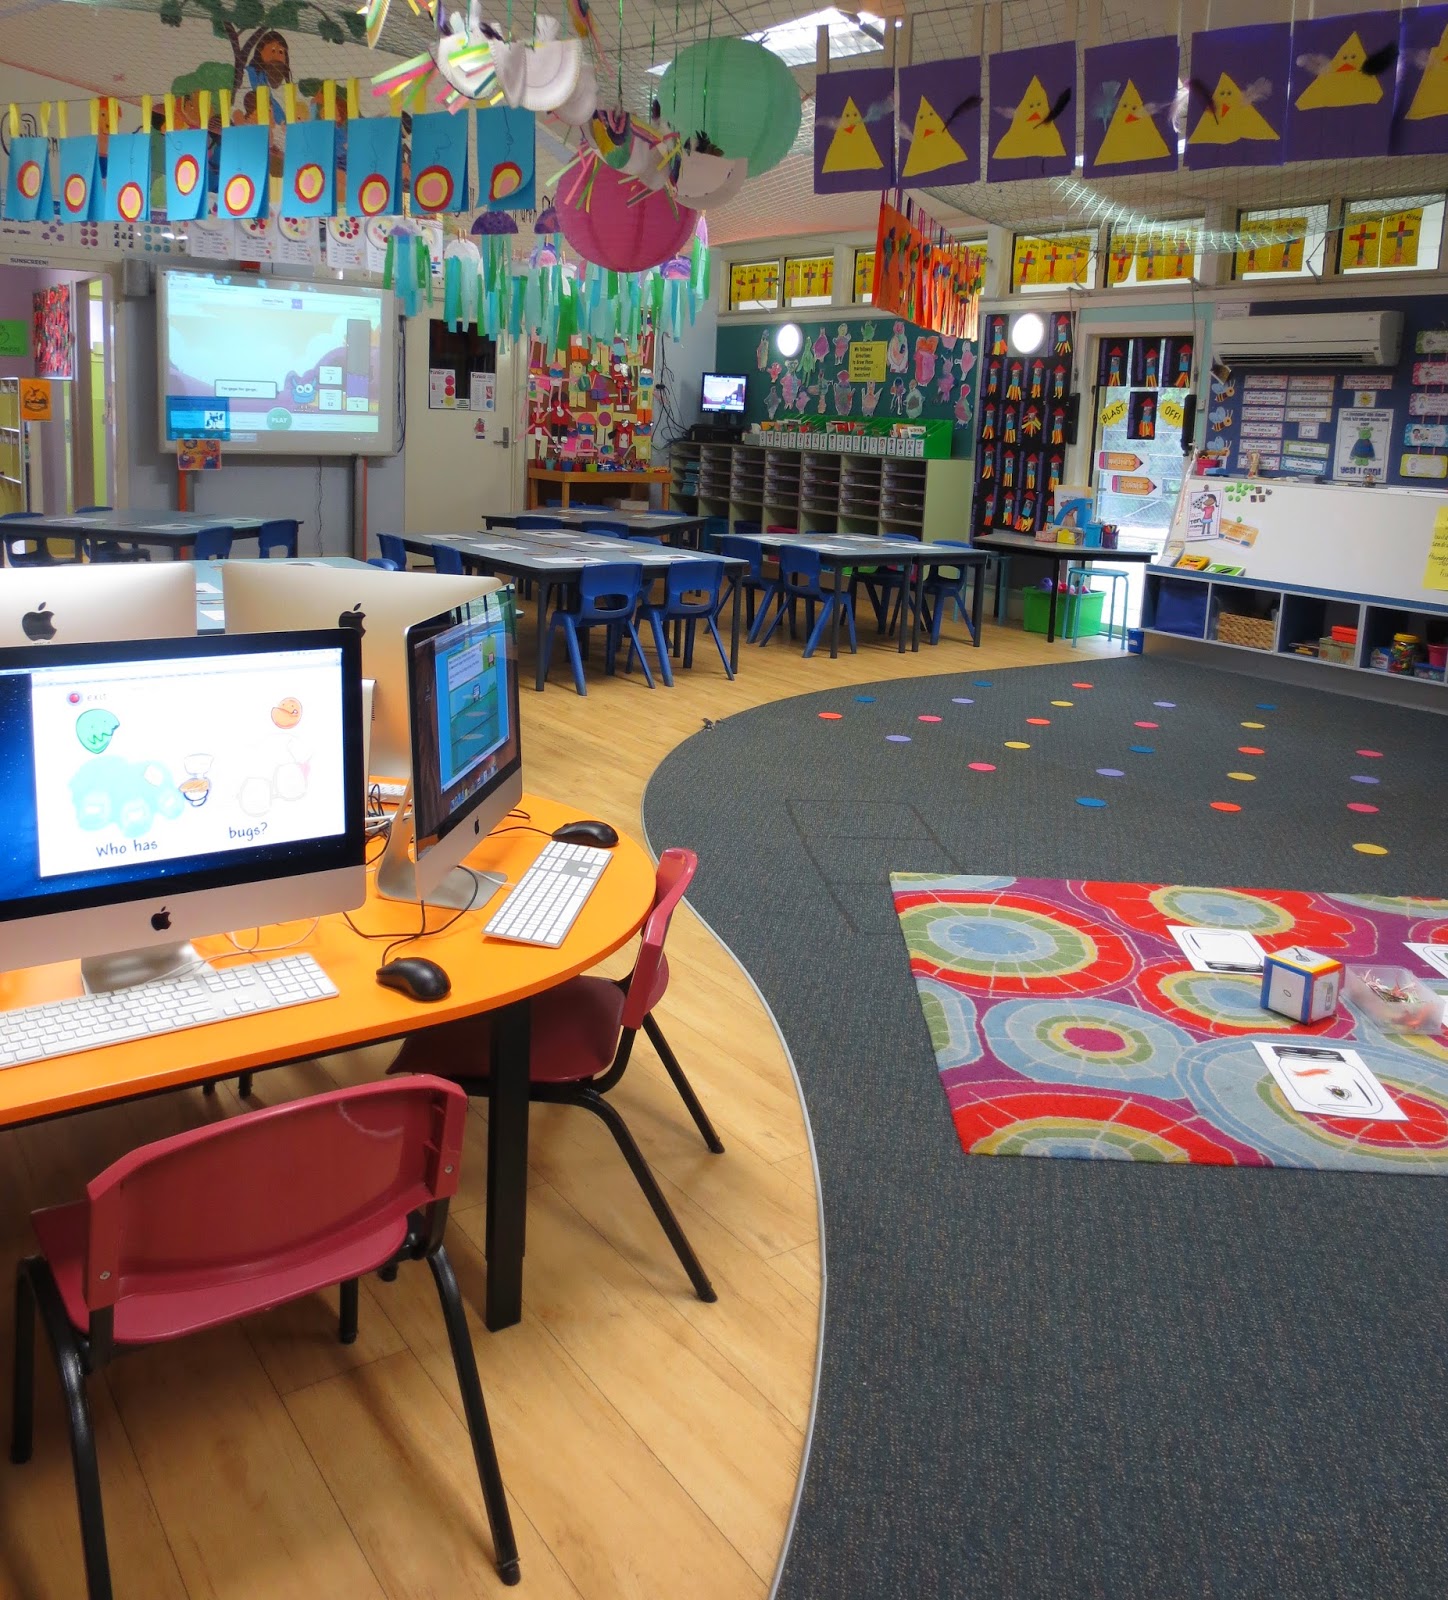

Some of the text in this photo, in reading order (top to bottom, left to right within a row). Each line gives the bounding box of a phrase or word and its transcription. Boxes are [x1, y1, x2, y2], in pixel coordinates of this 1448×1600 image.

[10, 257, 49, 266] SUNSCREEN!
[1102, 404, 1124, 423] BLAST
[1165, 405, 1181, 420] OFF!
[87, 692, 107, 701] exit
[229, 821, 268, 841] bugs?
[96, 839, 158, 857] Who has
